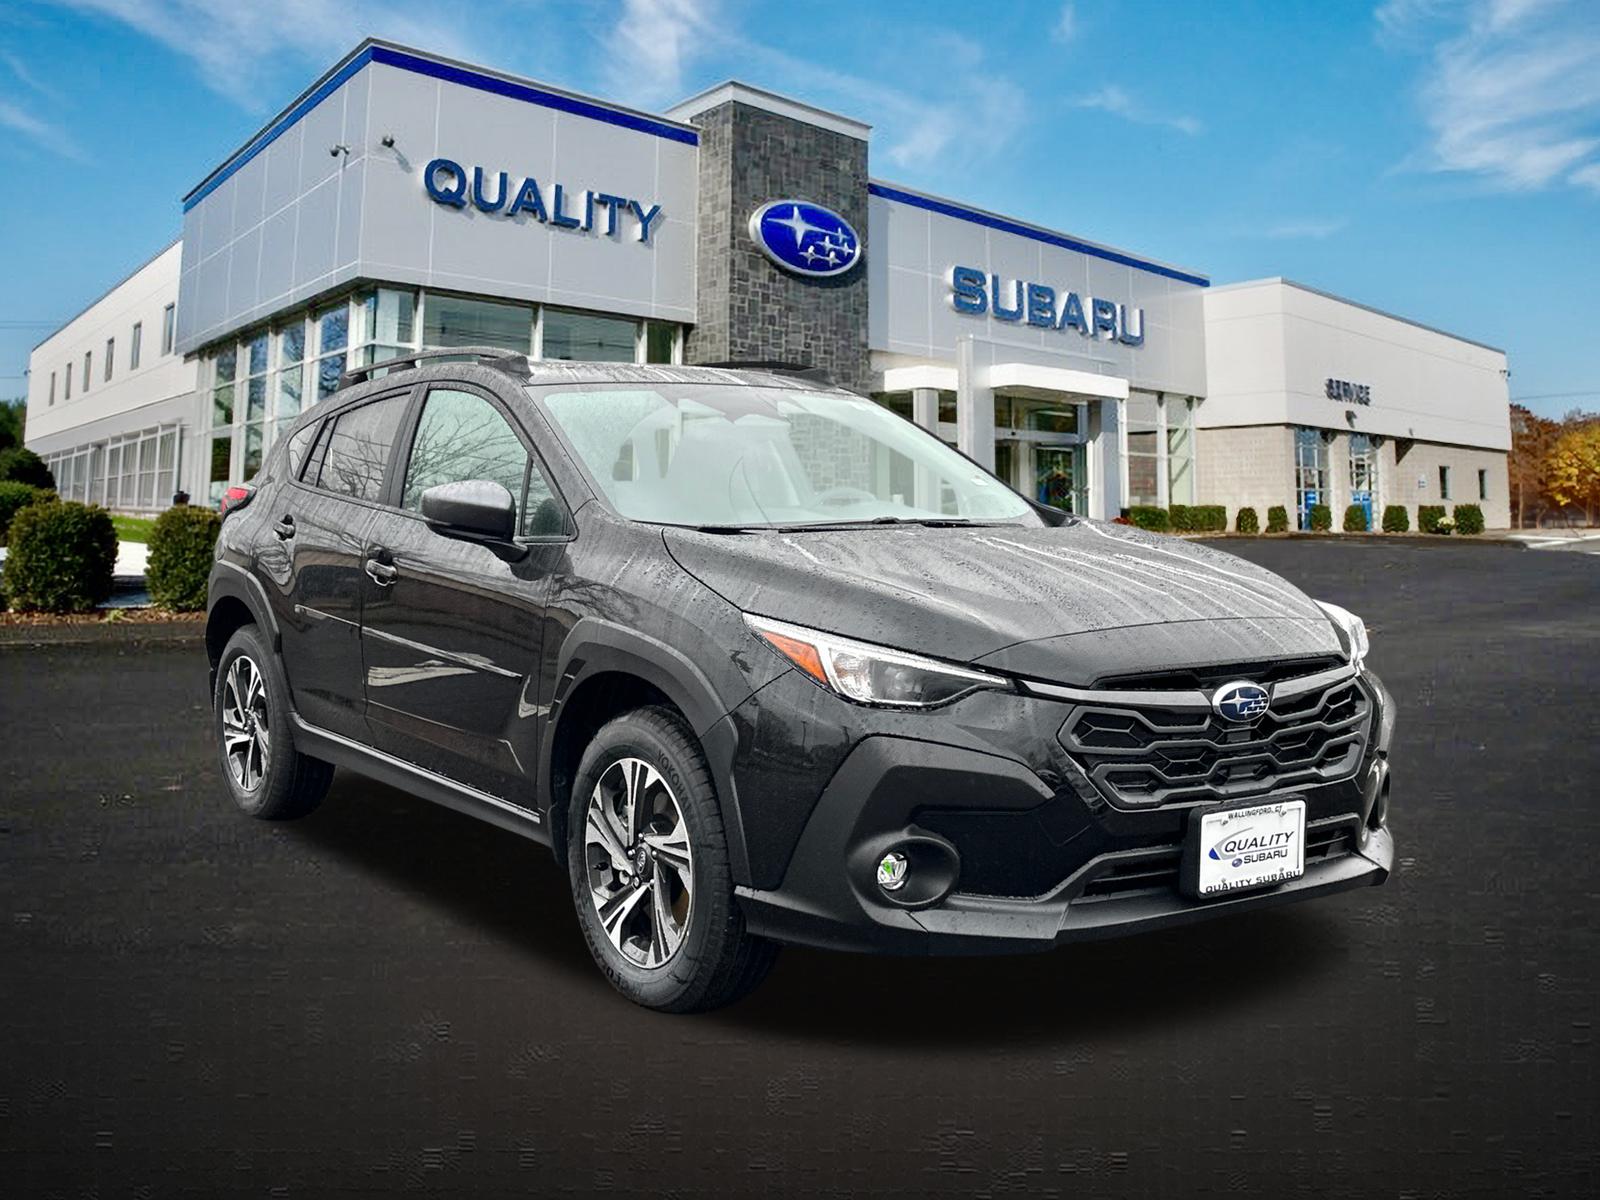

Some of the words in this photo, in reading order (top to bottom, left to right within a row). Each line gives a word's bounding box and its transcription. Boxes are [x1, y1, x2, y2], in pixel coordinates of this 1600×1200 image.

[424, 158, 661, 242] QUALITY
[951, 265, 1145, 346] SUBARU
[1224, 831, 1295, 853] QUALITY
[1243, 849, 1288, 864] SUBARU
[1205, 878, 1252, 894] QUALITY
[1256, 869, 1301, 883] SUBARU
